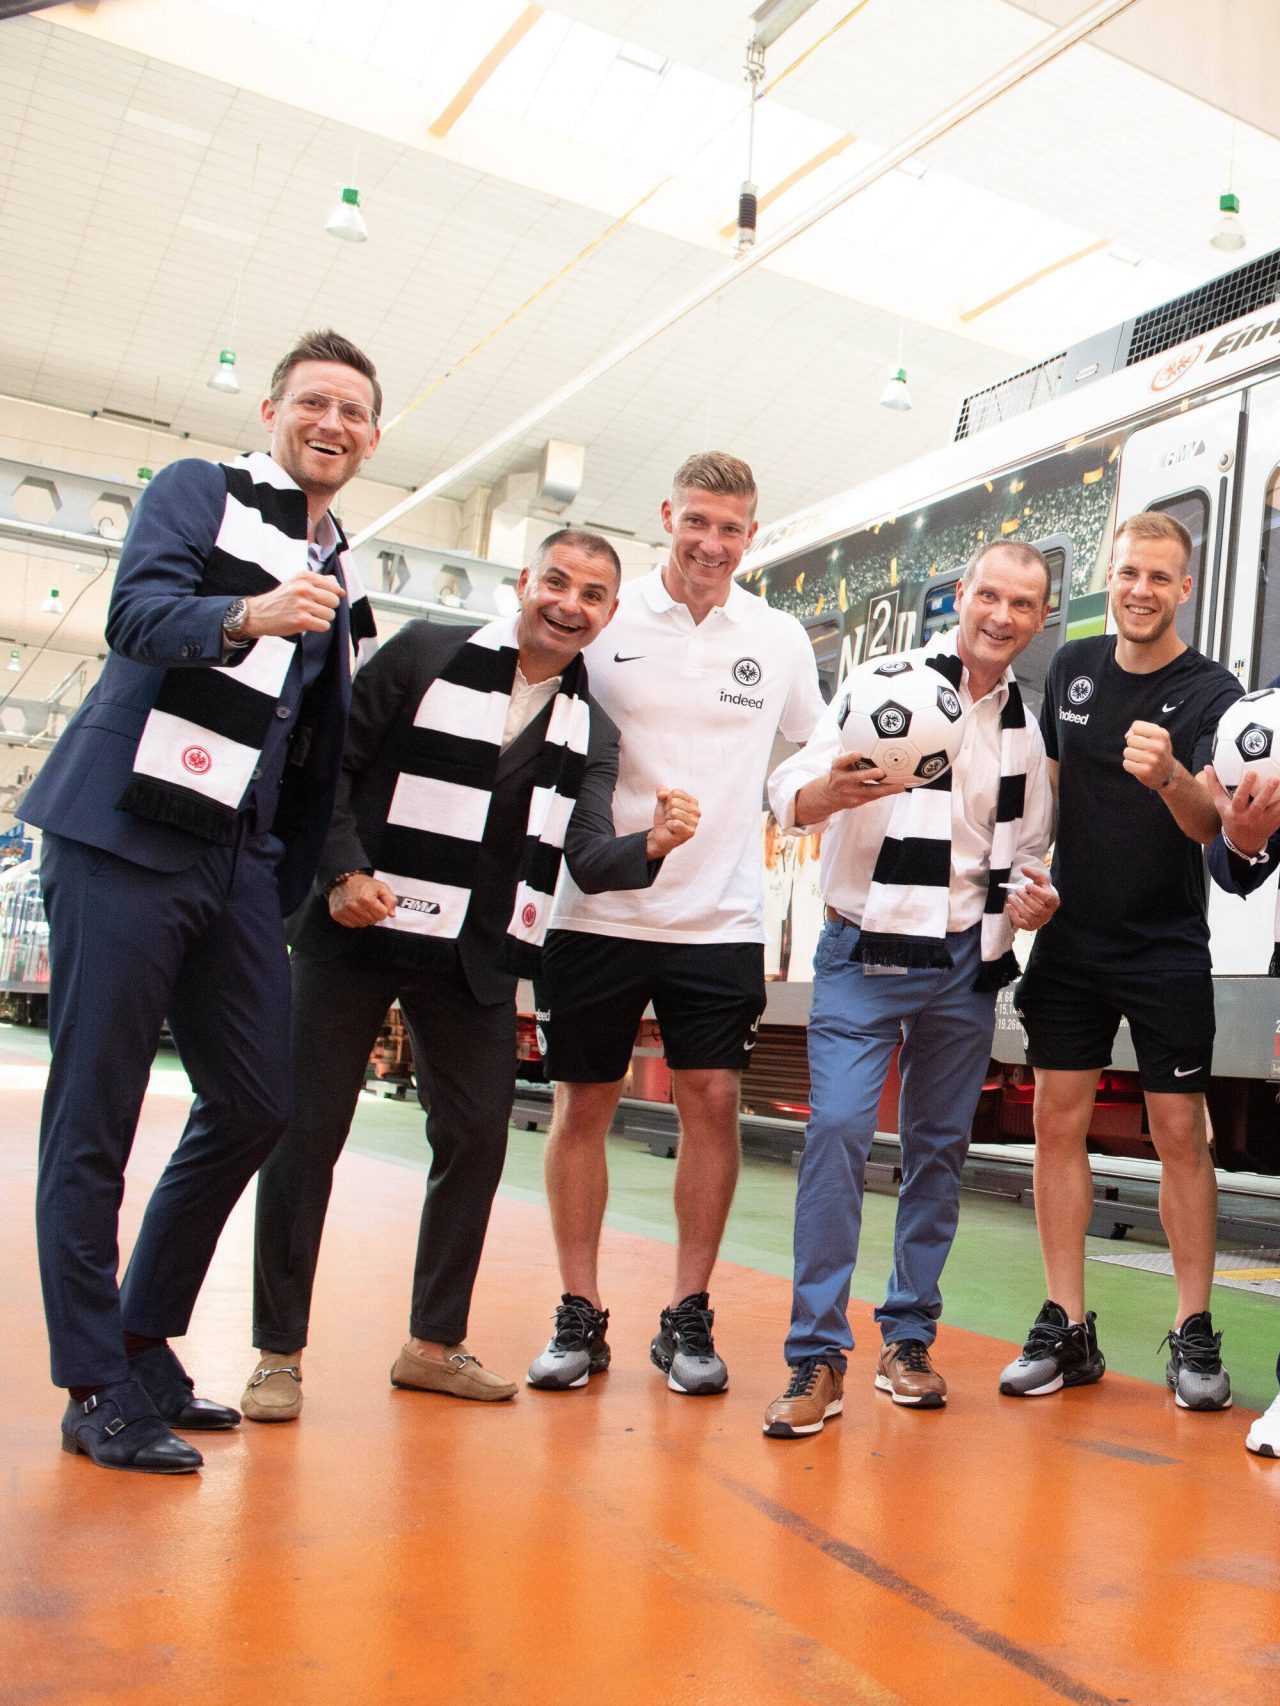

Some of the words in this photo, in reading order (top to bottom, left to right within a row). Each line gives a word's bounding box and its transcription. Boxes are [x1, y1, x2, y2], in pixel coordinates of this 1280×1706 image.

[868, 599, 892, 657] 2
[719, 690, 764, 710] indeed
[1058, 705, 1090, 725] indeed
[399, 896, 439, 914] RMV
